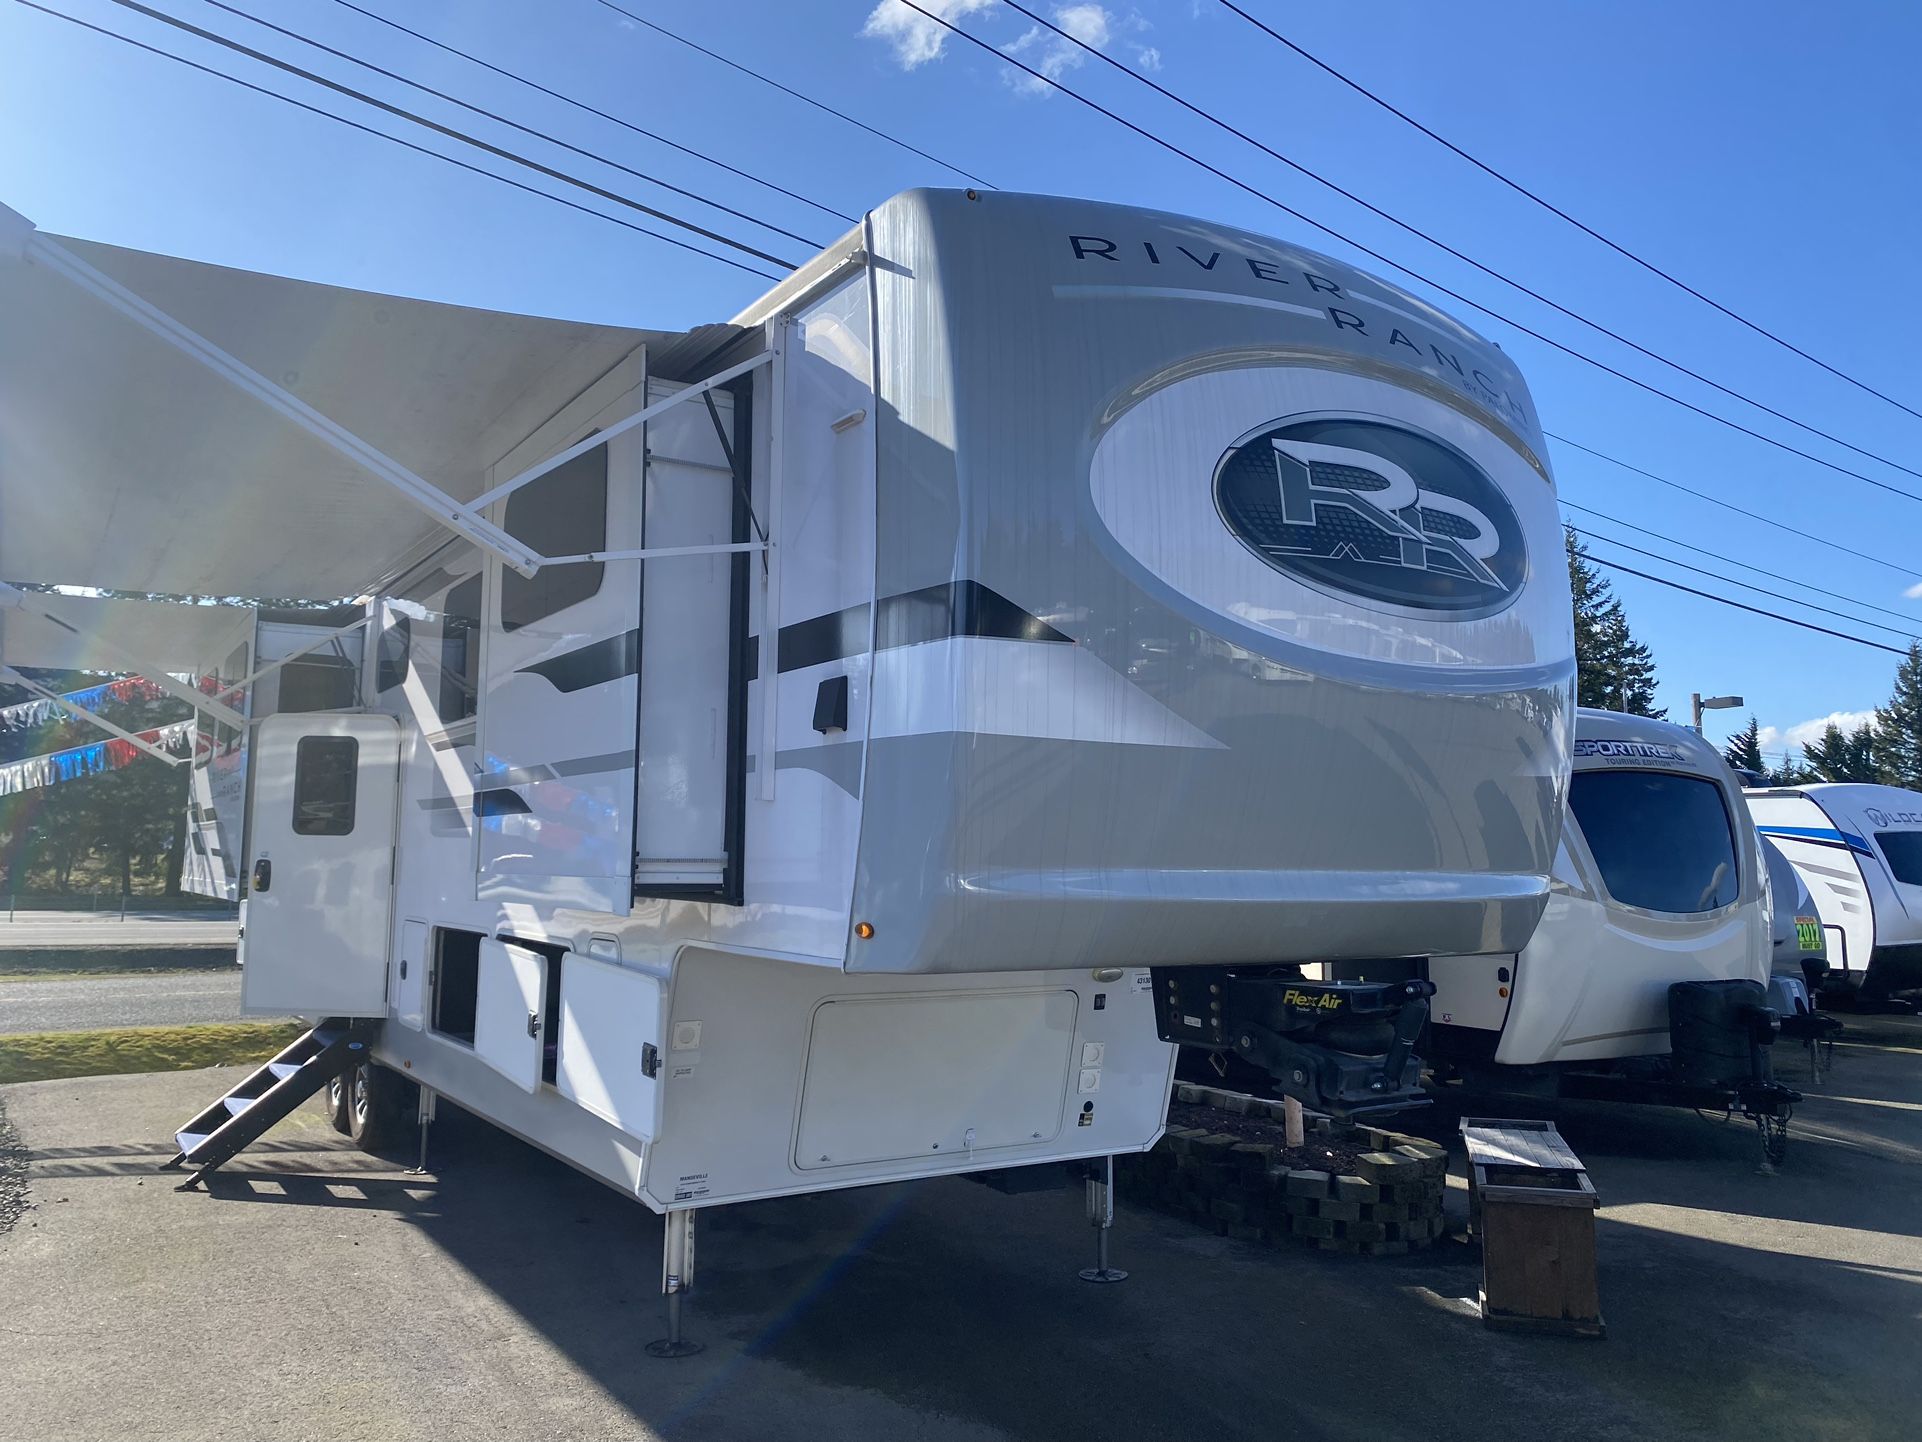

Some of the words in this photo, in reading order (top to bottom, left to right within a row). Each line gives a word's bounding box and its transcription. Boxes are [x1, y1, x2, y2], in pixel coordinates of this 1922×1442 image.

[1068, 234, 1342, 298] RIVER
[1327, 307, 1528, 425] RANCH
[1606, 758, 1641, 767] TOURING
[1642, 759, 1671, 768] EDITION
[1863, 807, 1922, 828] WILDC
[1796, 923, 1820, 942] 2017
